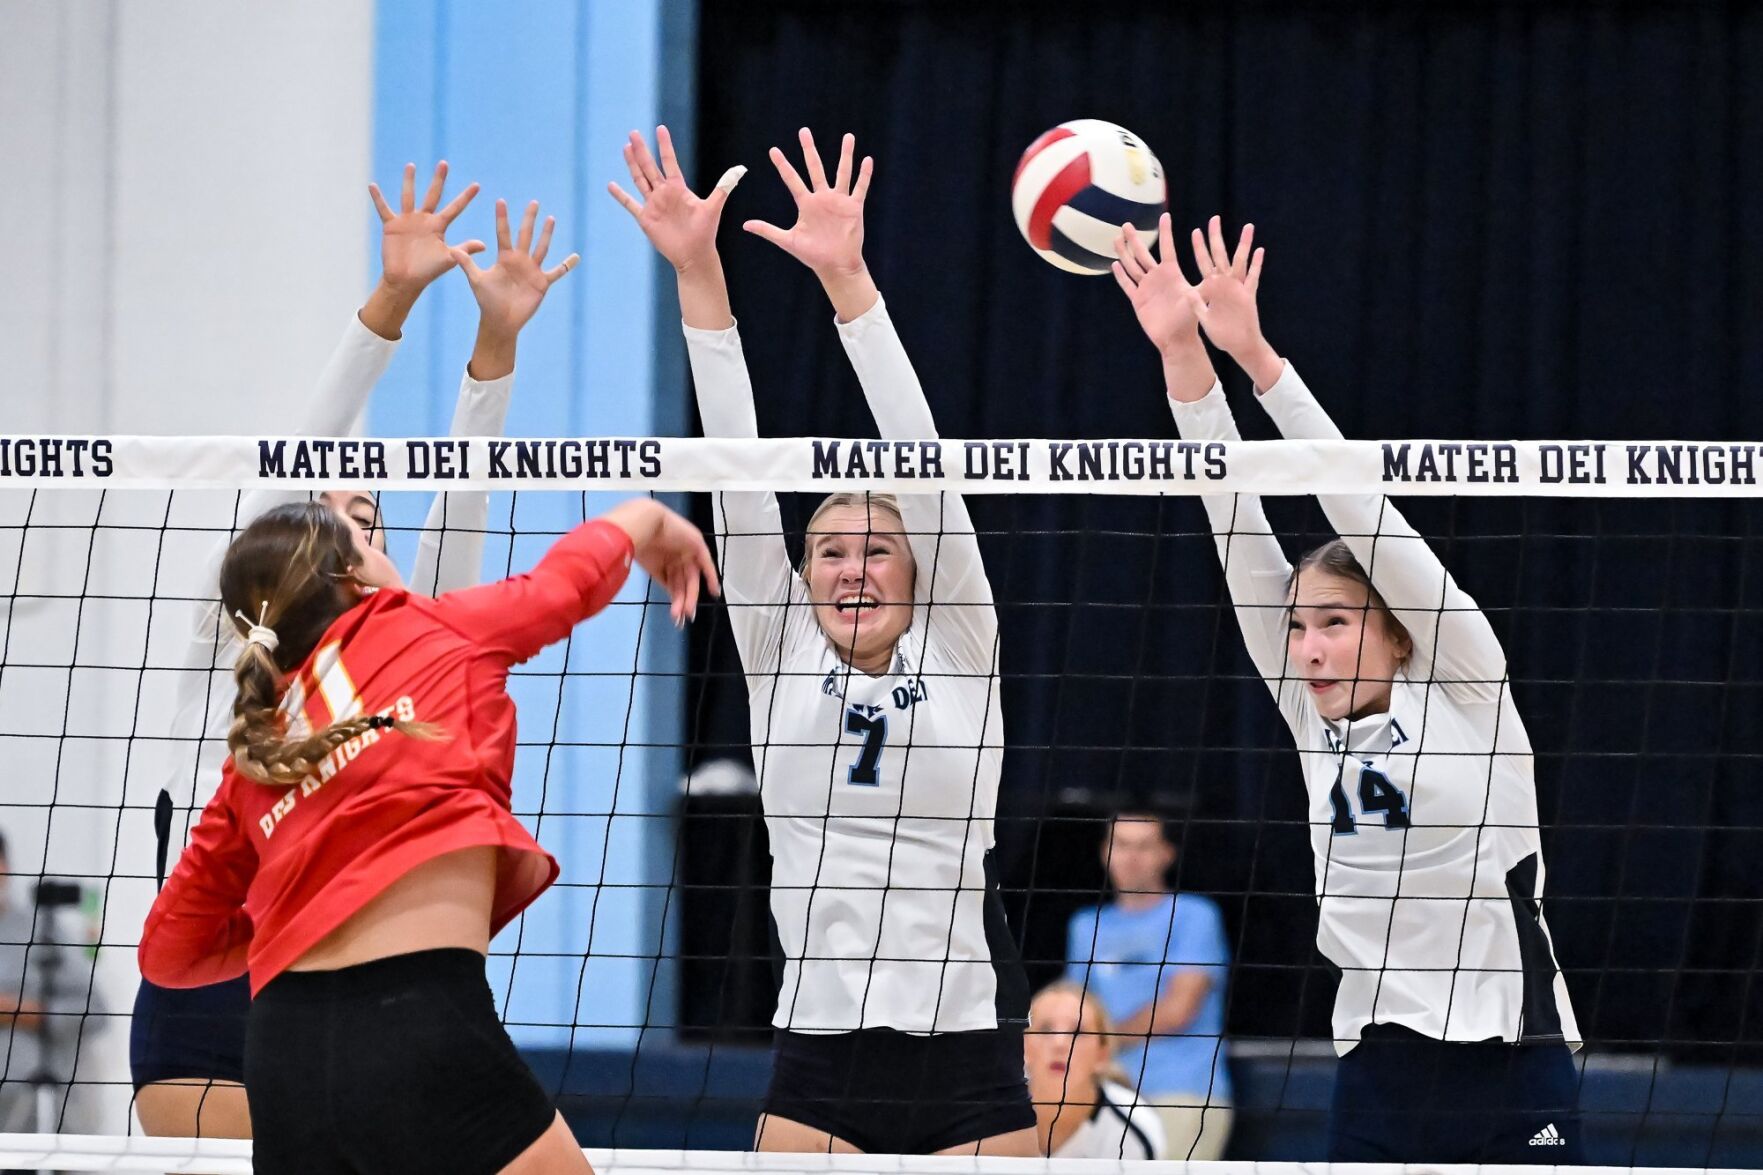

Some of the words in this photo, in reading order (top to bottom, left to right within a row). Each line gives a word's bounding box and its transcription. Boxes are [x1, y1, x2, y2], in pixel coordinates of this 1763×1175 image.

[0, 438, 114, 478] IGHTS
[258, 440, 388, 479] MATER
[406, 441, 470, 479] DEI
[487, 440, 662, 479] KNIGHTS
[811, 440, 945, 480] MATER
[963, 442, 1030, 481] DEI
[1048, 442, 1227, 481] KNIGHTS
[1381, 444, 1520, 483] MATER
[1538, 445, 1607, 484] DEI
[1626, 445, 1763, 485] KNIGH
[845, 708, 889, 788] 7
[1329, 762, 1411, 837] 14
